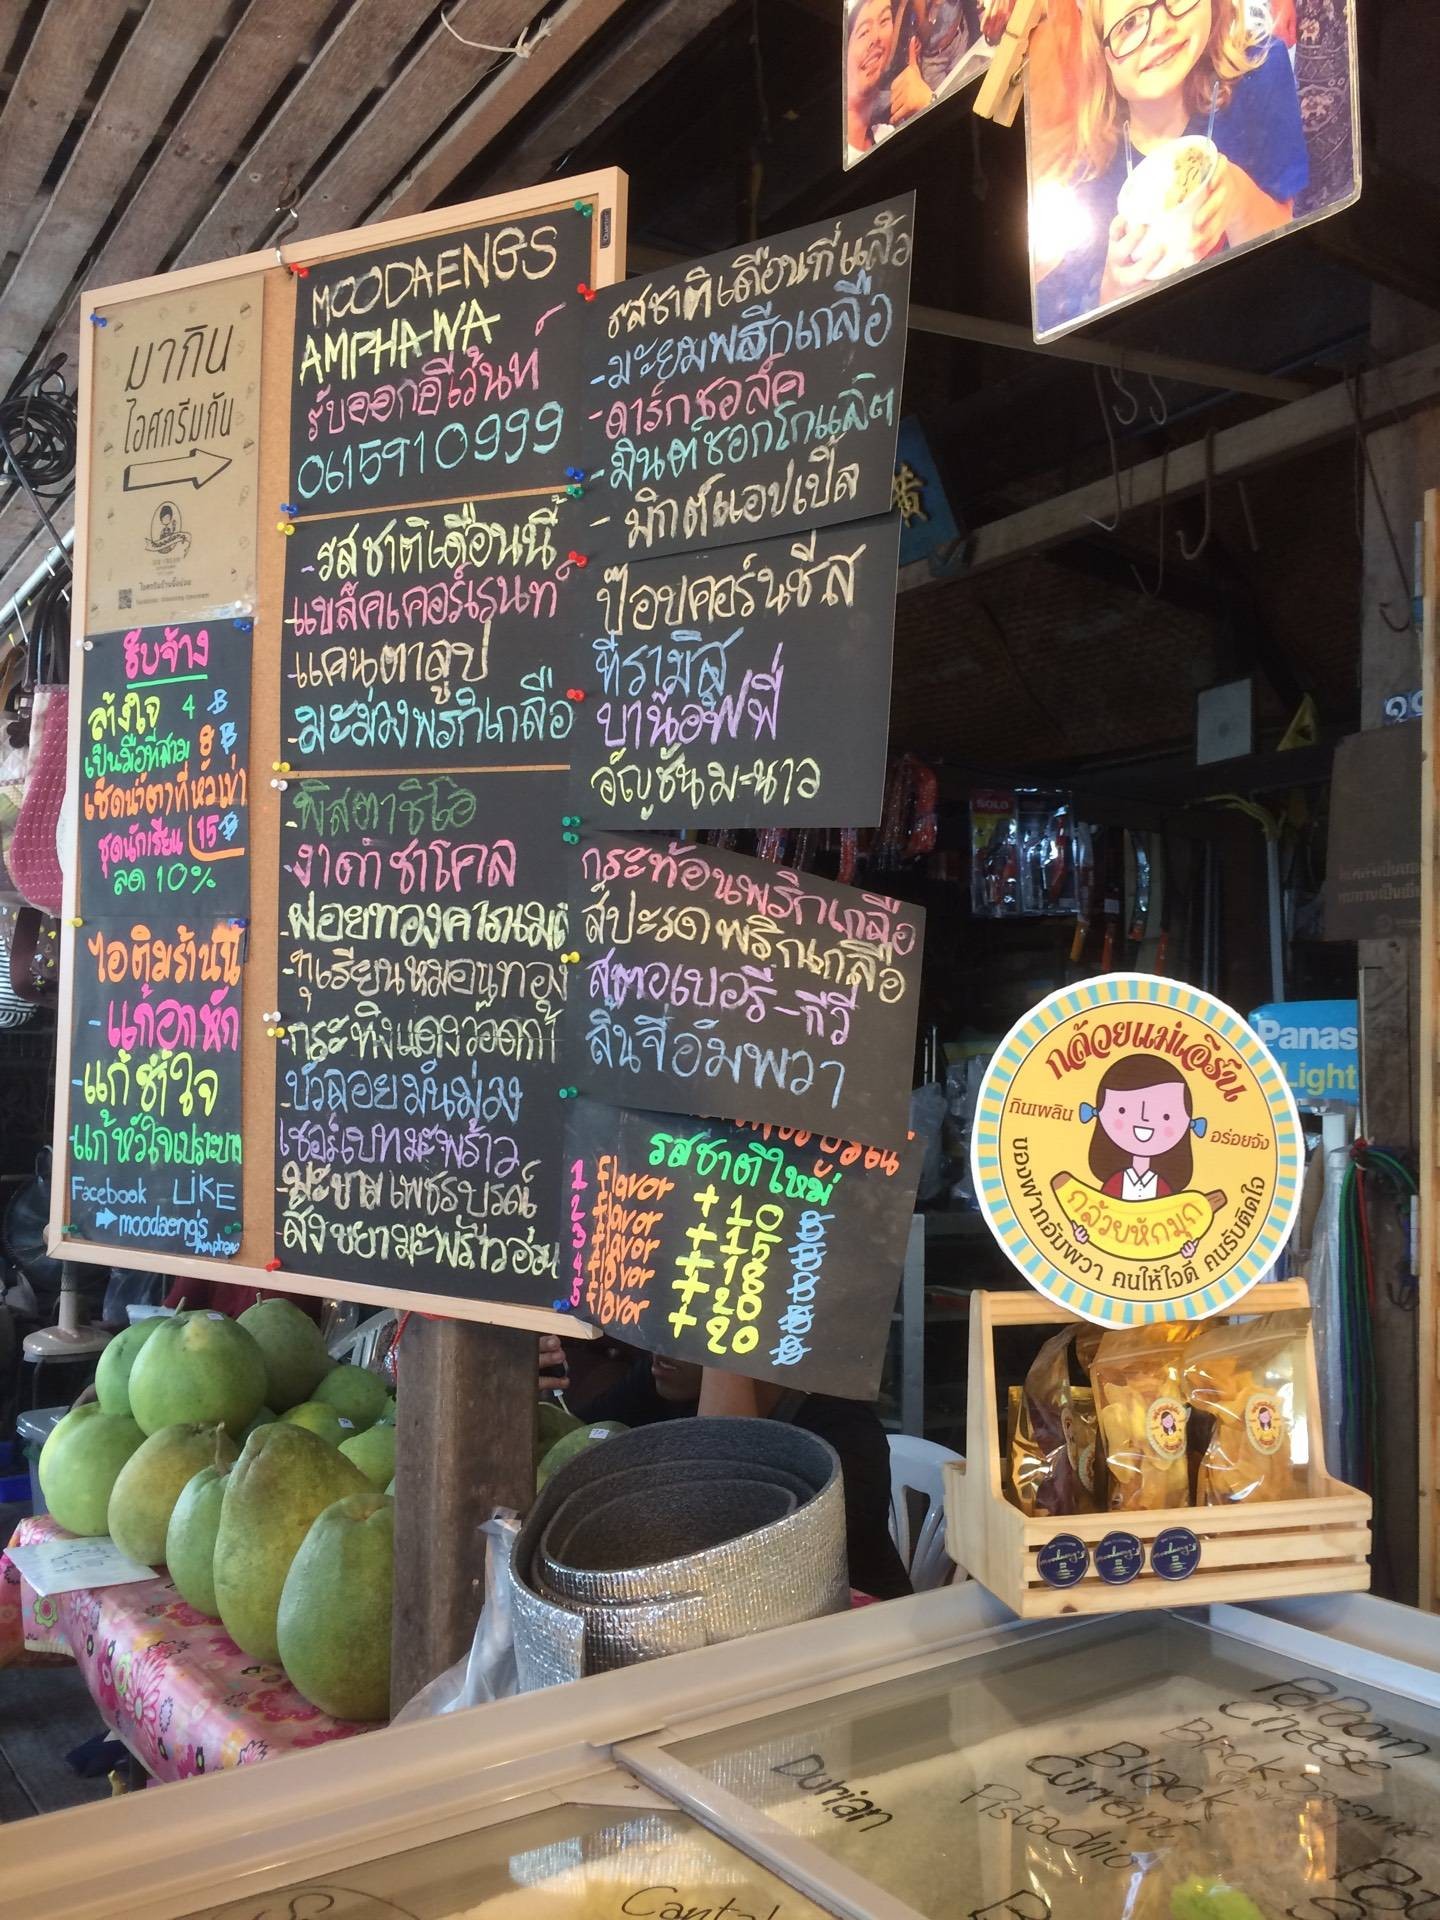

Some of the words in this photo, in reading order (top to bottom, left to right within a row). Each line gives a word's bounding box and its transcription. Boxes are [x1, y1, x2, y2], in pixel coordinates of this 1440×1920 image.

[124, 324, 234, 392] มากิน
[299, 298, 501, 386] AMPHAWA
[123, 391, 234, 454] ไอศกรีมกัน
[297, 401, 564, 498] 0615910999
[123, 627, 209, 680] รับจ้าง
[88, 691, 161, 741] ล้างใจ
[181, 693, 195, 720] 4
[200, 724, 215, 757] 8
[197, 814, 220, 849] 15
[113, 867, 146, 896] ลด
[1008, 1098, 1074, 1122] กินเพลิน
[1209, 1128, 1271, 1152] อร่อยจัง
[72, 1175, 148, 1205] Facebook
[1066, 1189, 1205, 1248] กล้วยหักมุก
[770, 1752, 894, 1834] Durian
